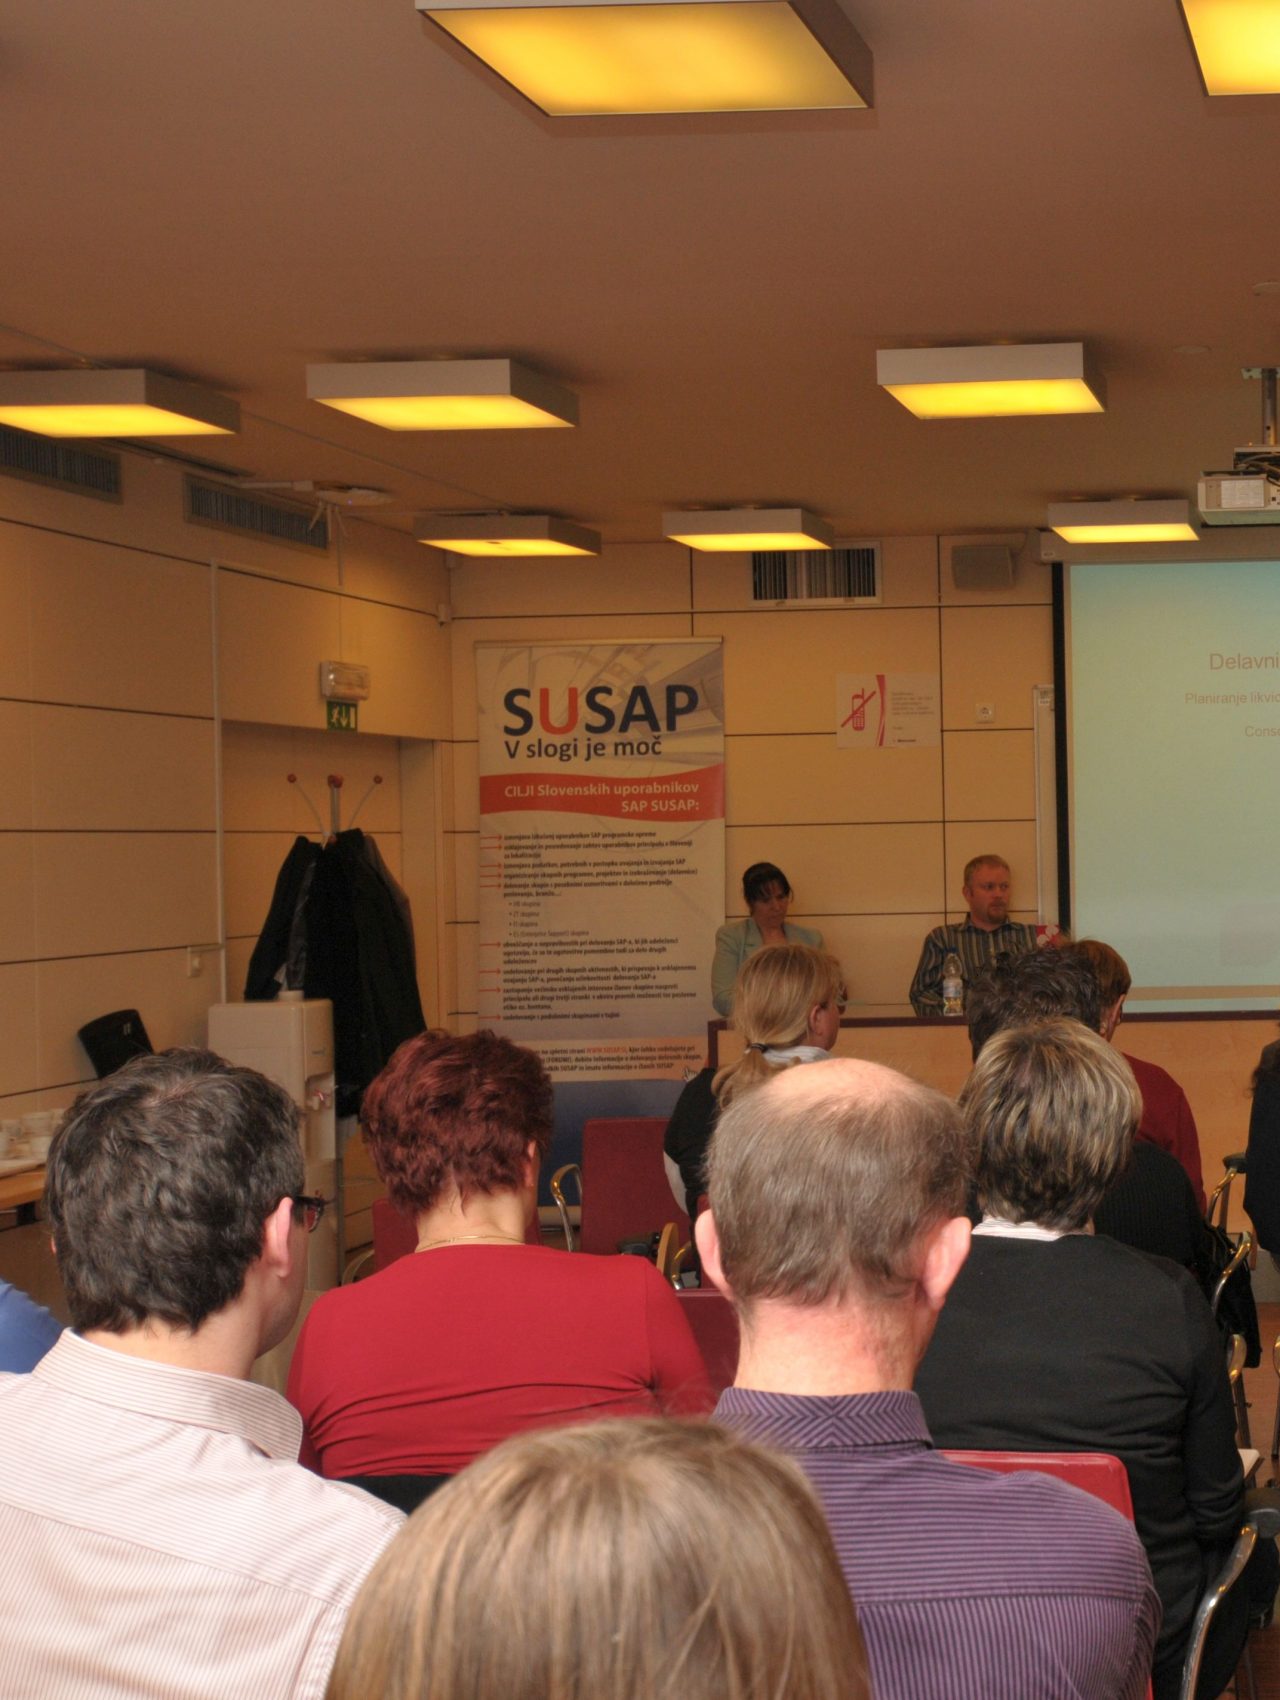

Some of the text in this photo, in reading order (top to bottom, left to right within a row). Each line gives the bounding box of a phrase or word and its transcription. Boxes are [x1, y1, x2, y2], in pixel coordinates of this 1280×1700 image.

[1185, 692, 1248, 706] Planiranje
[503, 684, 700, 736] SUSAP
[504, 735, 662, 762] V slogi je moč
[504, 781, 699, 798] CILJI Slovenskih uporabnikov
[621, 798, 699, 813] SAP SUSAP:
